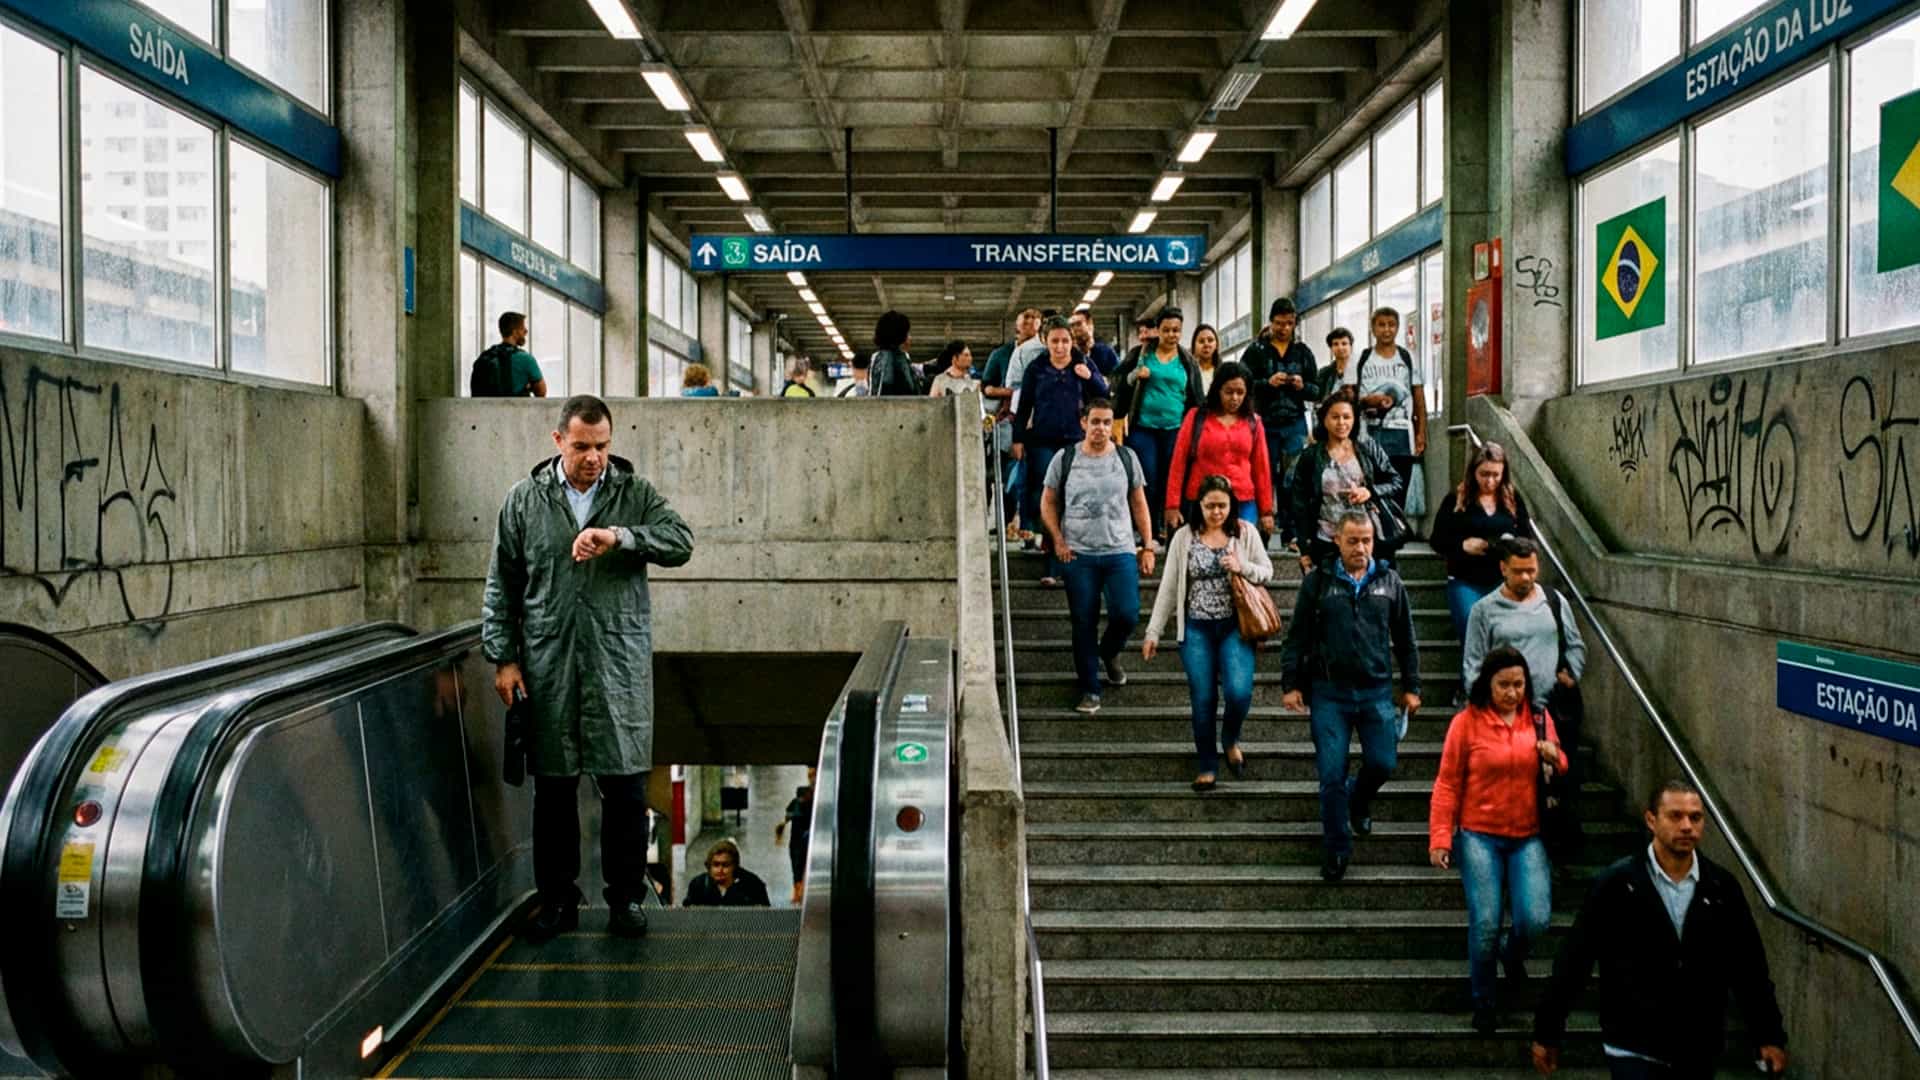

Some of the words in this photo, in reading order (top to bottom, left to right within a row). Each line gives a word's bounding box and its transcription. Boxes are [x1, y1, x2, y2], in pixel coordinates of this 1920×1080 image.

[129, 22, 189, 86] SAÍDA
[1686, 27, 1770, 101] ESTAÇÃO
[1775, 8, 1804, 53] DA
[753, 239, 822, 263] SAÍDA
[970, 238, 1160, 263] TRANSFERÊNCIA
[1816, 682, 1888, 724] ESTAÇÃO
[1893, 699, 1918, 731] DA
